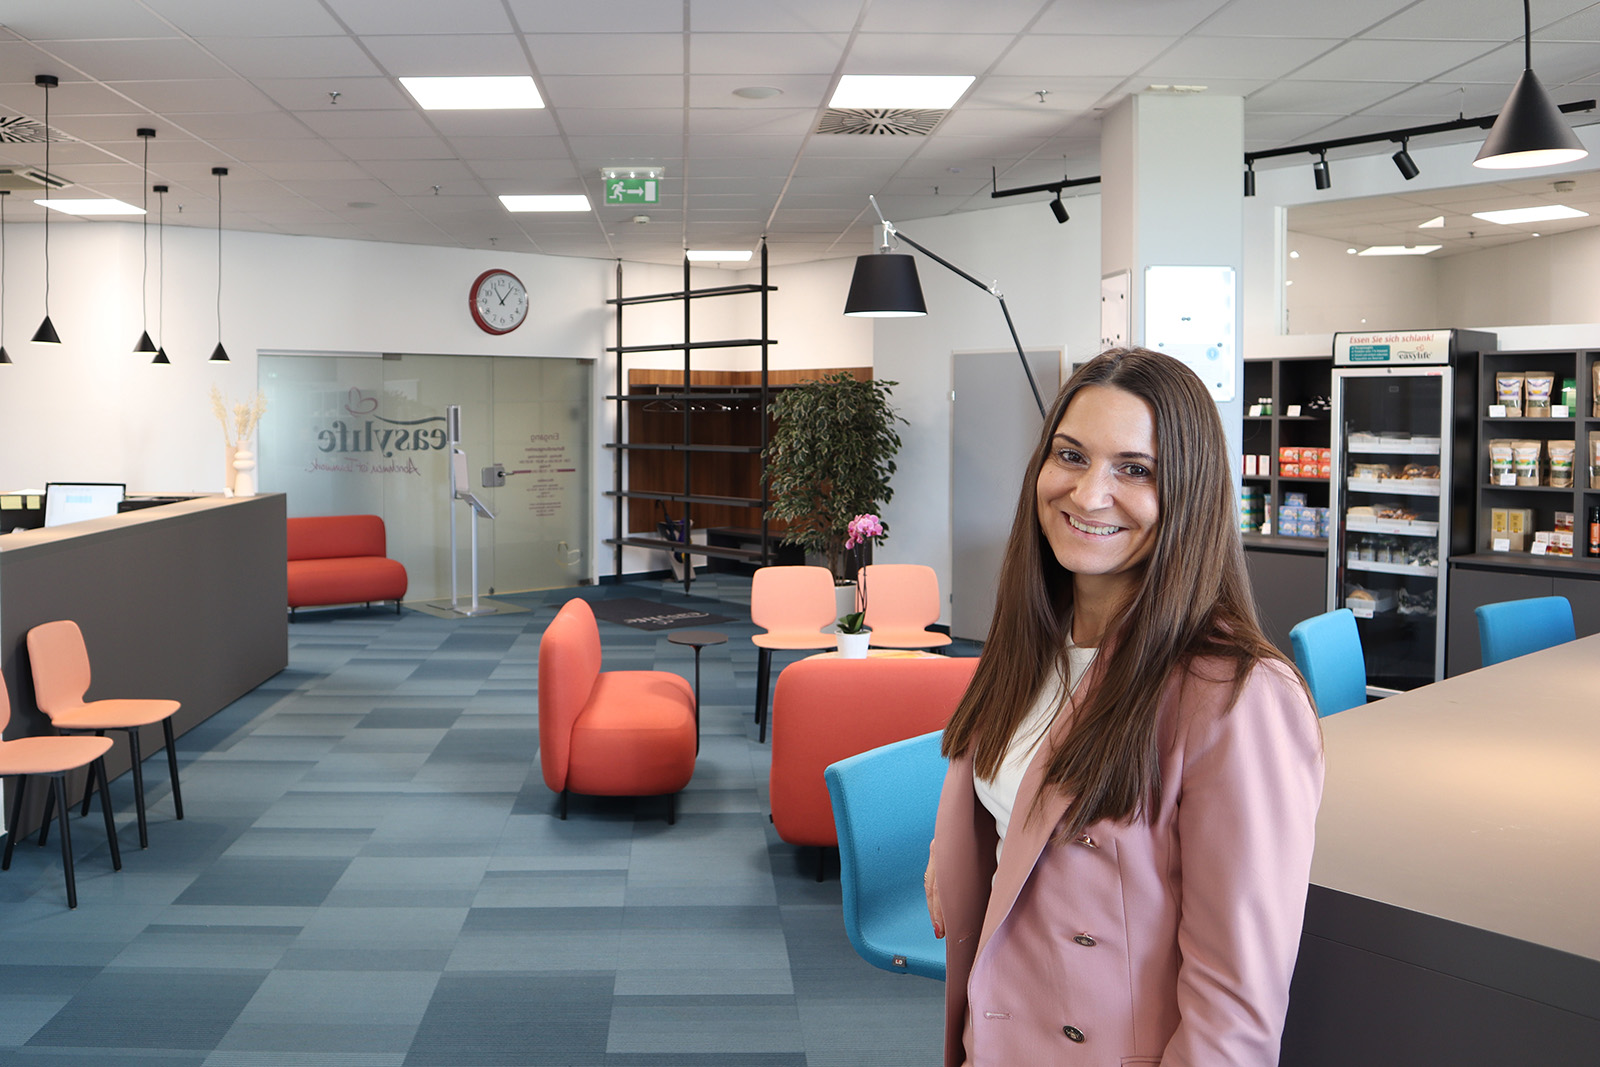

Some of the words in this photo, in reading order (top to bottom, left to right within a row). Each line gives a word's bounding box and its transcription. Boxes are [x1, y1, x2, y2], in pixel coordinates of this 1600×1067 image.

[498, 279, 505, 287] 12
[485, 289, 493, 297] 10
[1349, 335, 1370, 344] Essen
[1372, 335, 1383, 344] Sie
[1385, 335, 1400, 343] sich
[1402, 334, 1435, 342] schlank!
[1398, 351, 1431, 361] easylife
